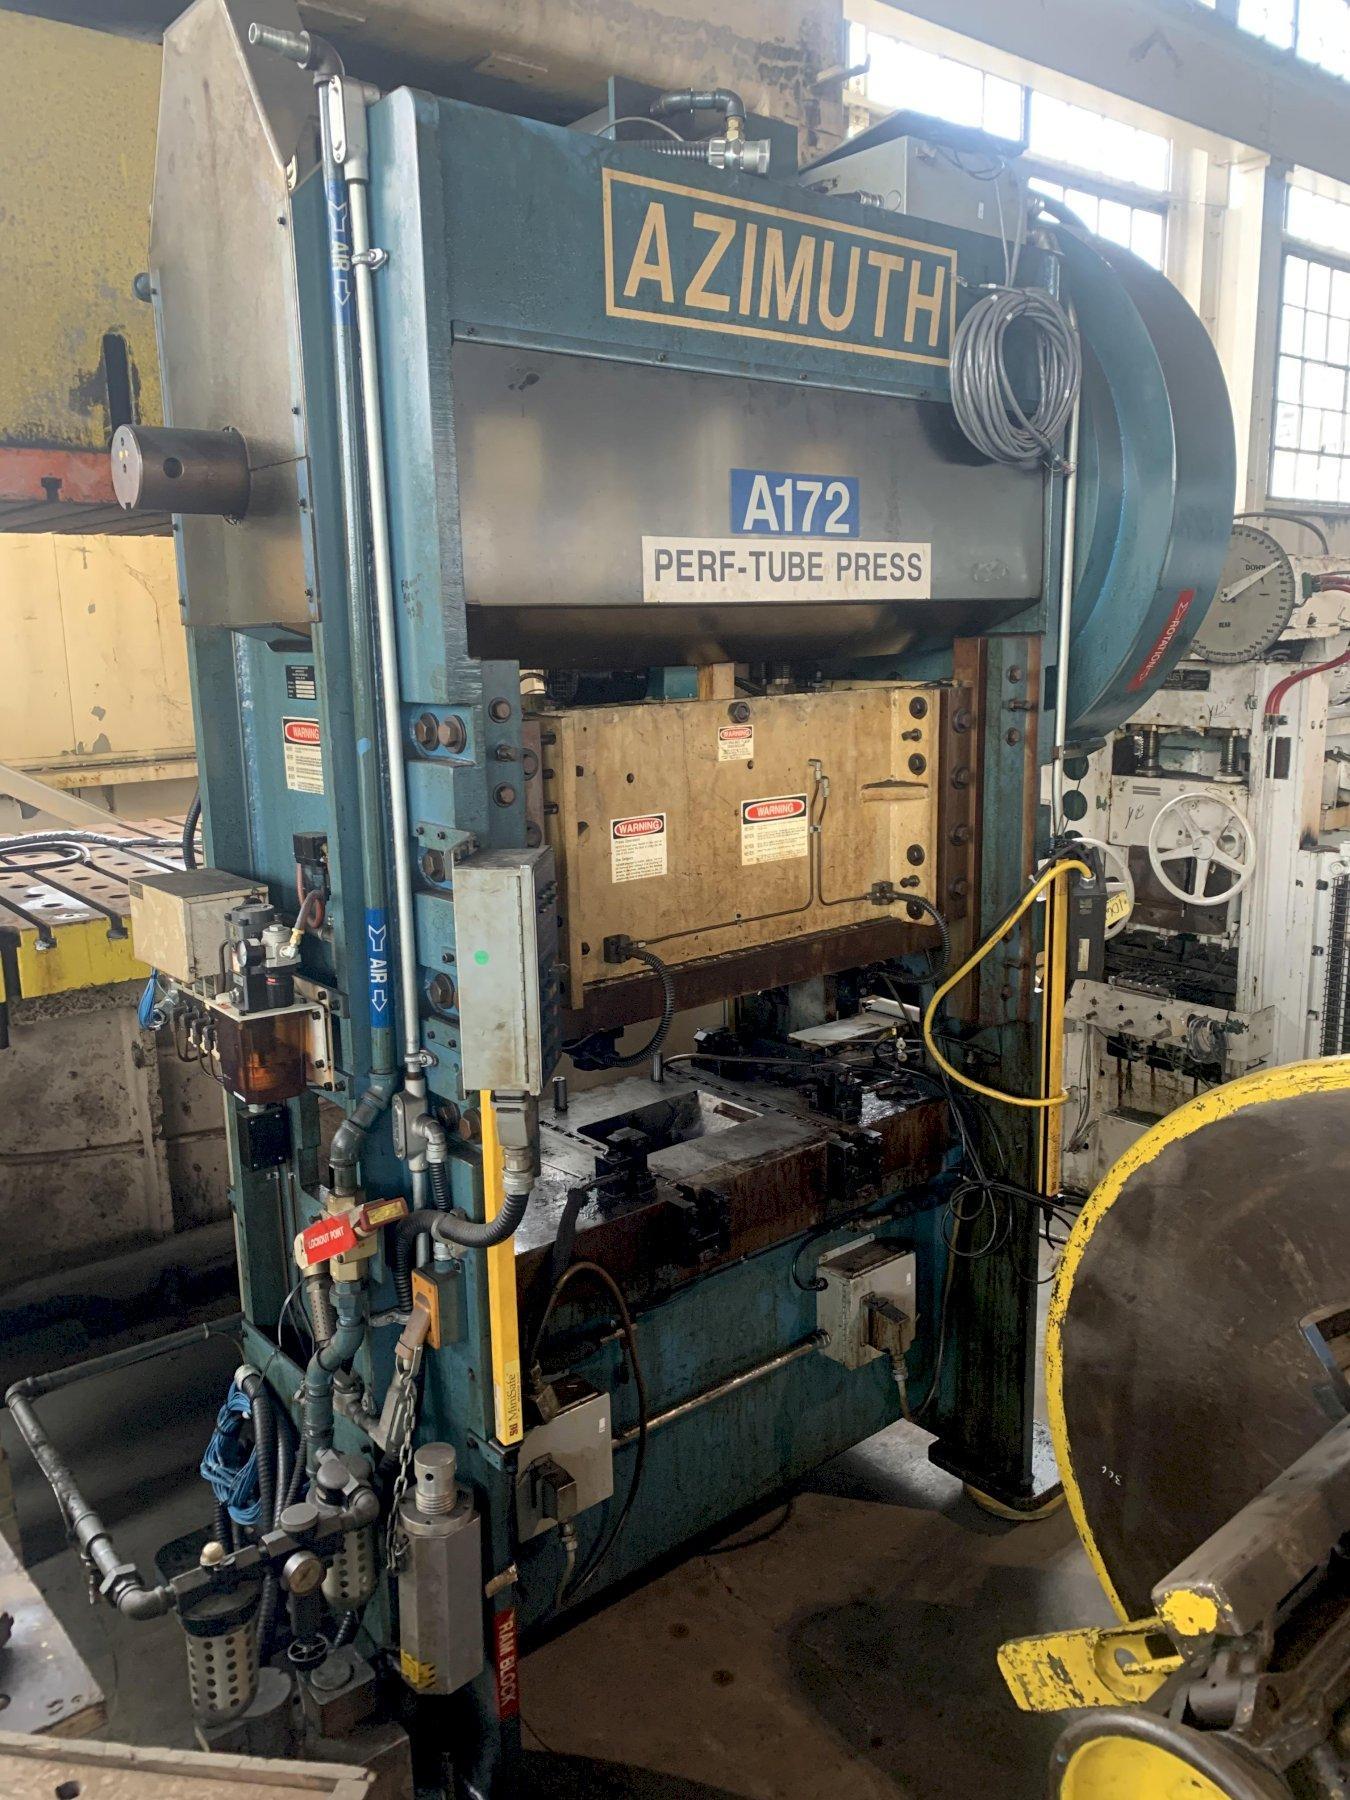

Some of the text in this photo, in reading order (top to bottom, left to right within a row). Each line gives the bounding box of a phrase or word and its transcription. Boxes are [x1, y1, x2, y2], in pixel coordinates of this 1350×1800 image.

[332, 241, 350, 271] AIR
[623, 201, 946, 347] AZIMUTH
[742, 474, 851, 534] A172
[654, 548, 923, 582] PERF-TUBE PRESS
[1146, 619, 1181, 672] ROTATION
[292, 726, 320, 740] WARNING
[756, 802, 794, 817] WARNING
[619, 820, 660, 834] WARNING
[369, 958, 388, 983] AIR
[308, 1226, 345, 1250] LOCKOUT POINT
[499, 1620, 517, 1707] RAM BLOCK
